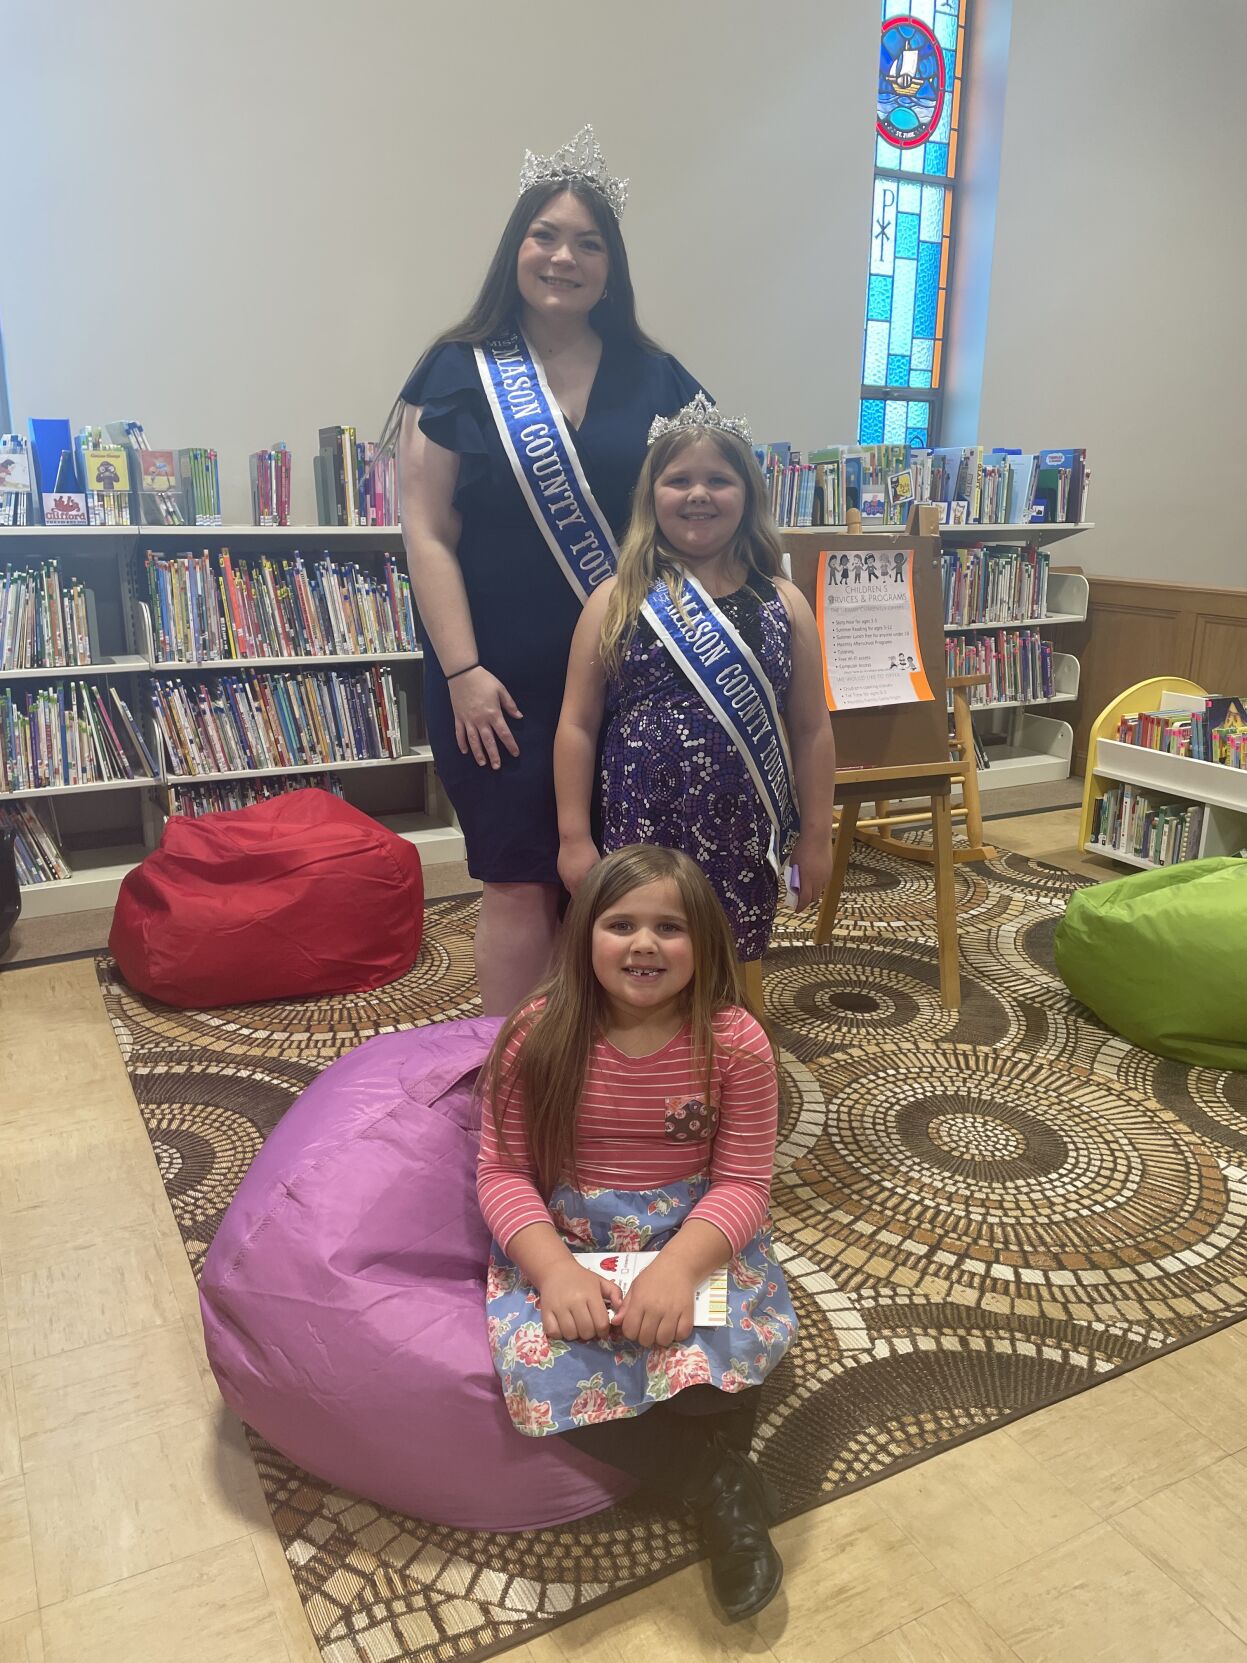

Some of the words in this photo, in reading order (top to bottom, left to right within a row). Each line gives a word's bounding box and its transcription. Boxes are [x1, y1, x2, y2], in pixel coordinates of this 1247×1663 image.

[491, 347, 541, 419] MASON
[520, 423, 586, 530] COUNTY
[46, 511, 86, 521] Clifford
[868, 592, 907, 602] PROGRAMS
[664, 592, 730, 667] MASON
[716, 663, 772, 745] COUNTY
